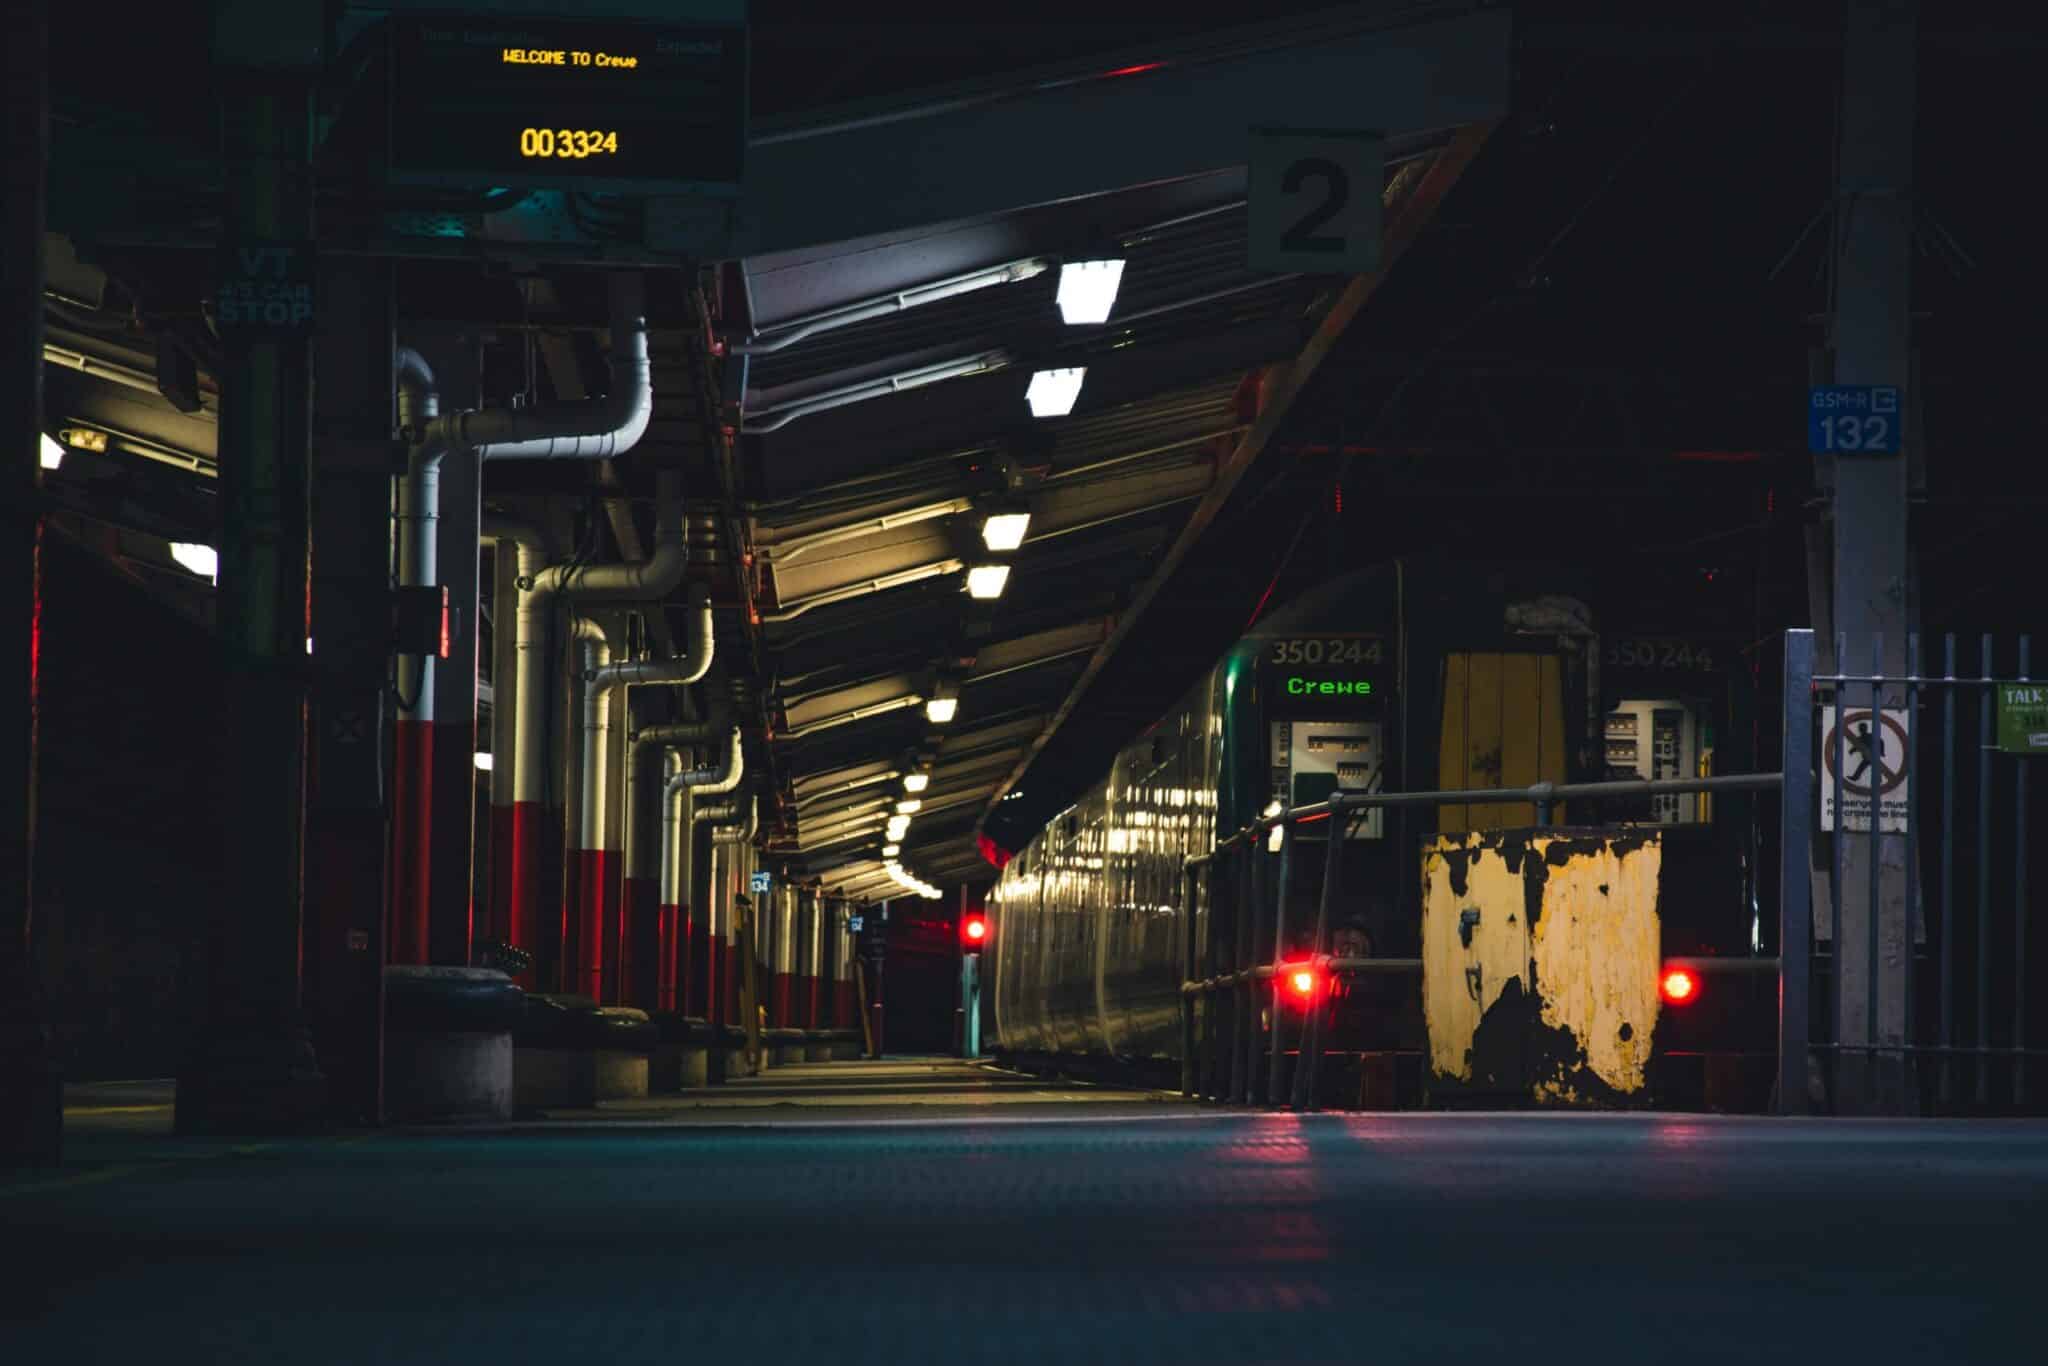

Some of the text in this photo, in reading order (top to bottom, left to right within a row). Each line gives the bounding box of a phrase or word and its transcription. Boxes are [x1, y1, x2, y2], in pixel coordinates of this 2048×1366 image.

[503, 48, 638, 69] WELCOME TO Crewe
[1280, 158, 1349, 251] 2
[217, 303, 312, 325] STOP
[1813, 391, 1868, 408] GSM-R
[1821, 416, 1888, 449] 132
[1271, 640, 1382, 664] 350 244
[1287, 677, 1371, 695] Crewe
[2005, 688, 2043, 705] TALK
